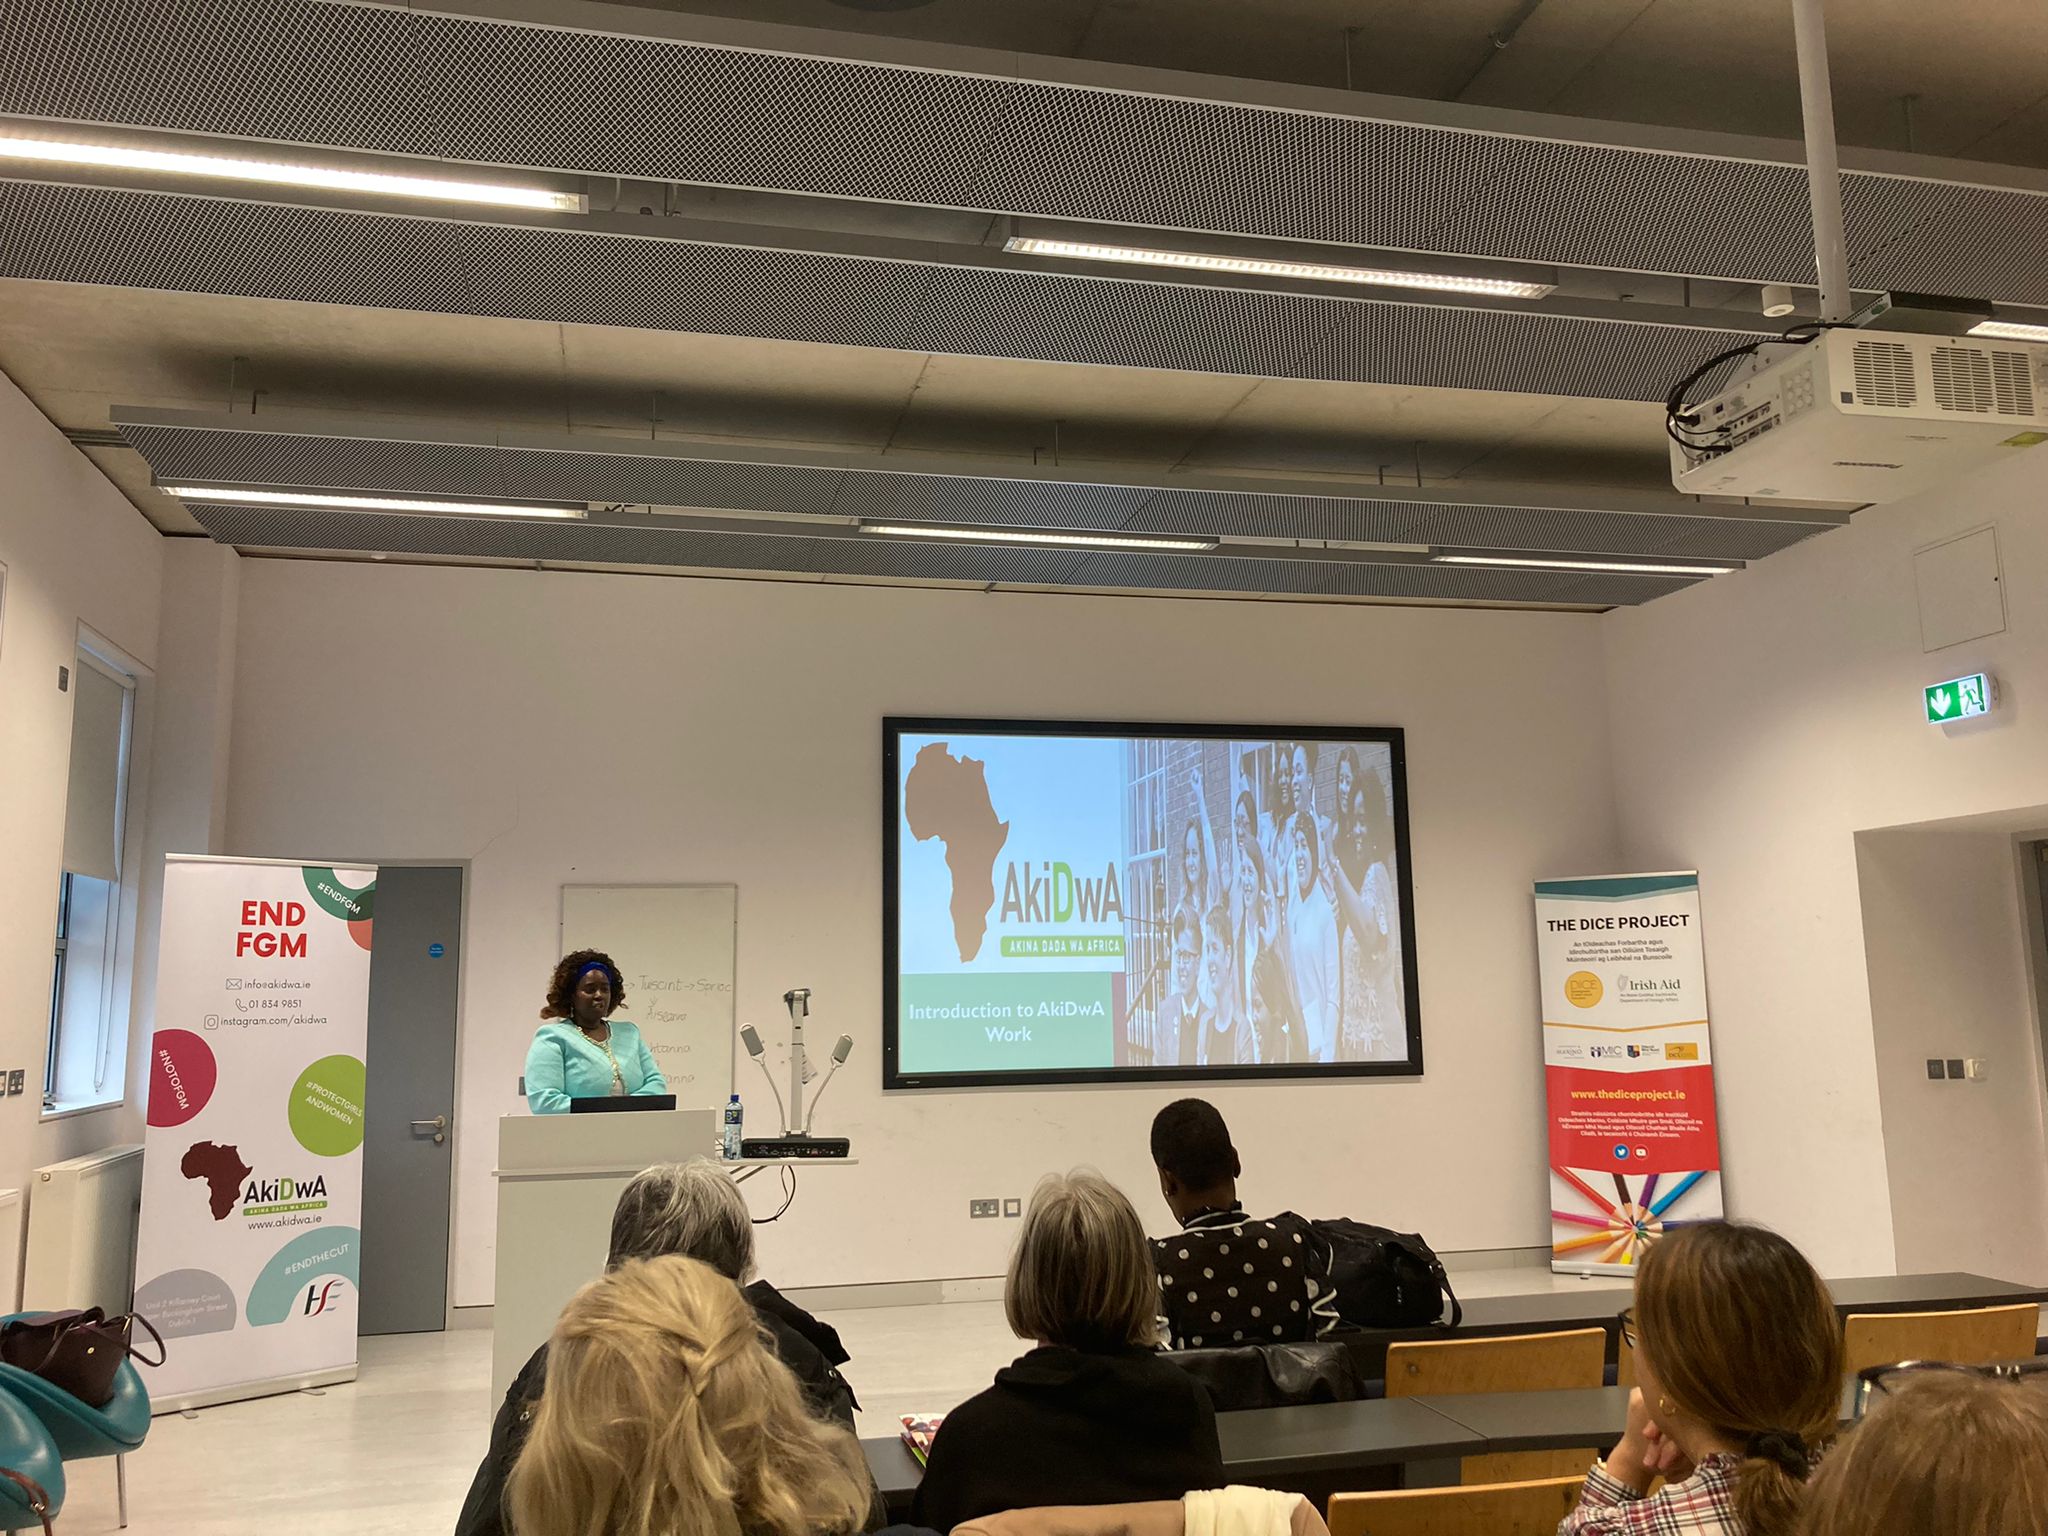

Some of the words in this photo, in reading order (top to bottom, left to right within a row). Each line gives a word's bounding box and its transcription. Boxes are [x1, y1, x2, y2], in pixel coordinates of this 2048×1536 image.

[317, 882, 361, 915] #ENDFGM
[1000, 861, 1124, 923] AkiDwA
[241, 900, 306, 927] END
[1547, 919, 1577, 932] THE
[1580, 917, 1615, 931] DICE
[1618, 914, 1690, 929] PROJECT
[236, 931, 307, 958] FGM
[1009, 940, 1039, 953] AKINA
[1042, 940, 1067, 953] DADA
[1069, 940, 1084, 952] WA
[1087, 940, 1121, 952] AFRICA
[244, 978, 311, 989] info@akidwa.ie
[1629, 979, 1658, 991] Irish
[1660, 978, 1682, 990] Aid
[248, 999, 259, 1009] 01
[261, 999, 279, 1009] 834
[281, 999, 302, 1009] 9851
[909, 1002, 1012, 1020] Introduction
[1017, 1003, 1034, 1018] to
[1037, 1001, 1105, 1018] AkiDwA
[220, 1013, 328, 1028] instagram.com/akidwa
[985, 1026, 1033, 1043] Work
[159, 1049, 190, 1110] #NOTOFGM
[305, 1081, 363, 1117] #PROTECTGIRLS
[1570, 1089, 1686, 1102] www.thediceproject.ie
[305, 1095, 353, 1125] ANDWOMEN
[243, 1175, 327, 1204] AkiDwA
[248, 1214, 322, 1230] www.akidwa.ie
[284, 1243, 350, 1275] #ENDTHECUT
